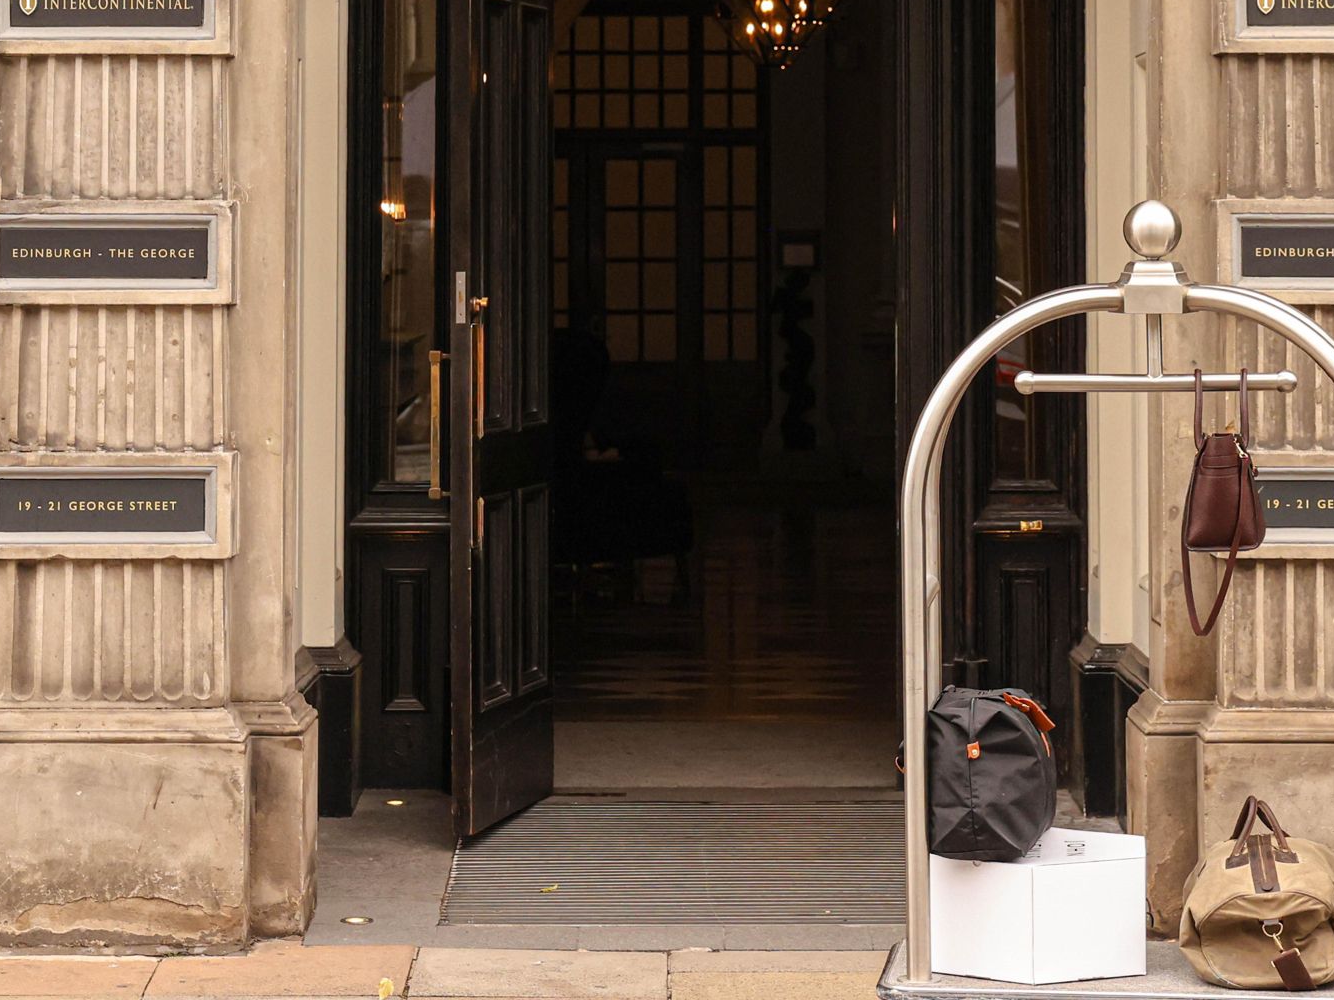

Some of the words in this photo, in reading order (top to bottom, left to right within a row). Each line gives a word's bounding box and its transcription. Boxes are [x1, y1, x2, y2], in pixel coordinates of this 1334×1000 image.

[12, 248, 92, 258] EDINBURGH
[108, 248, 134, 258] THE
[140, 248, 195, 259] GEORGE
[1255, 247, 1334, 257] EDINBURGH
[18, 501, 31, 511] 19
[48, 501, 61, 511] 21
[68, 500, 124, 511] GEORGE
[129, 500, 178, 511] STREET
[1266, 499, 1280, 509] 19
[1296, 499, 1310, 509] 21
